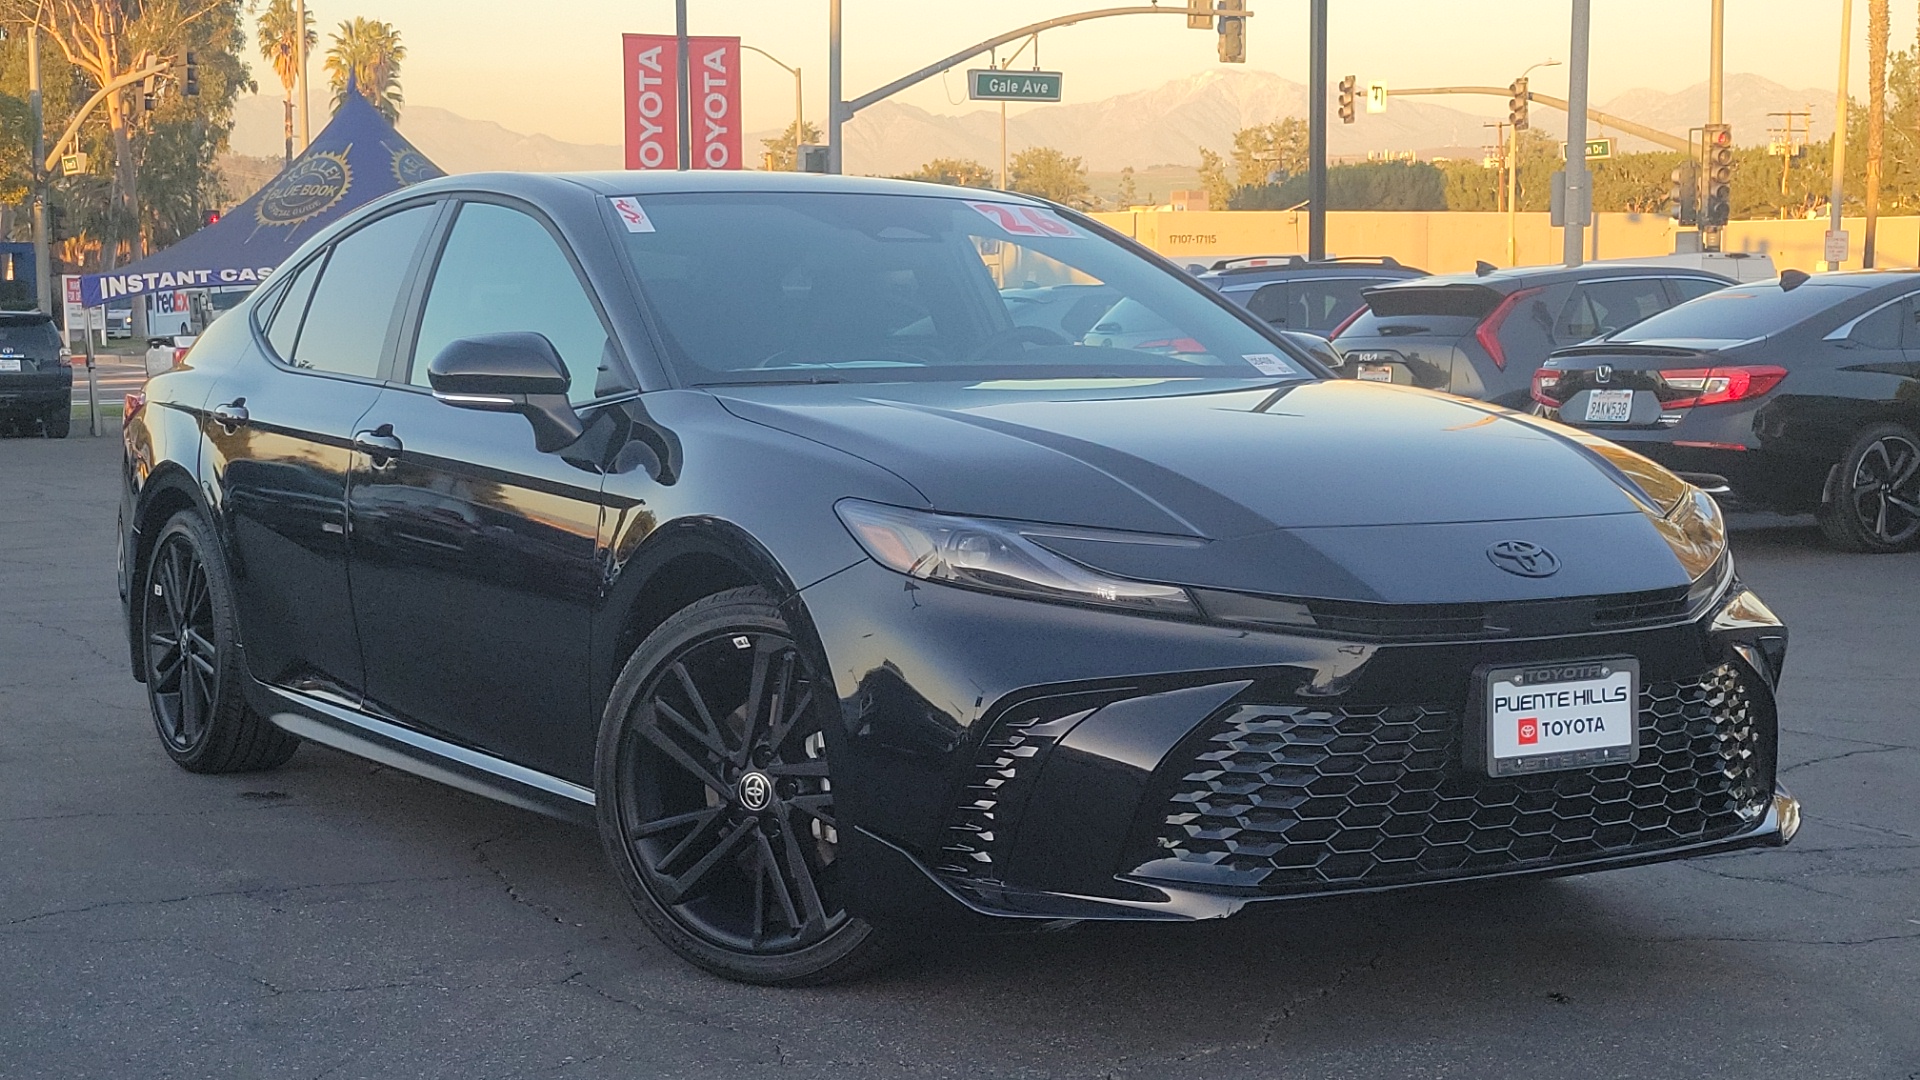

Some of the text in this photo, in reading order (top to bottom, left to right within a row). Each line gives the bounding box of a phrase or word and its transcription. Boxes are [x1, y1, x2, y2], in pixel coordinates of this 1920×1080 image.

[989, 79, 1049, 94] Gale Ave
[638, 46, 664, 169] OYOTA
[703, 47, 729, 169] OYOTA
[1592, 144, 1603, 154] Dr
[288, 159, 342, 182] KELLEY
[268, 184, 340, 200] BLUE BOOK
[973, 204, 1072, 235] 26
[1169, 234, 1217, 244] 17107-17115
[100, 269, 212, 299] INSTANT
[220, 267, 273, 282] CAS
[1525, 665, 1601, 682] TOYOTA
[1495, 686, 1627, 713] PUENTE HILLS
[1541, 717, 1605, 737] TOYOTA
